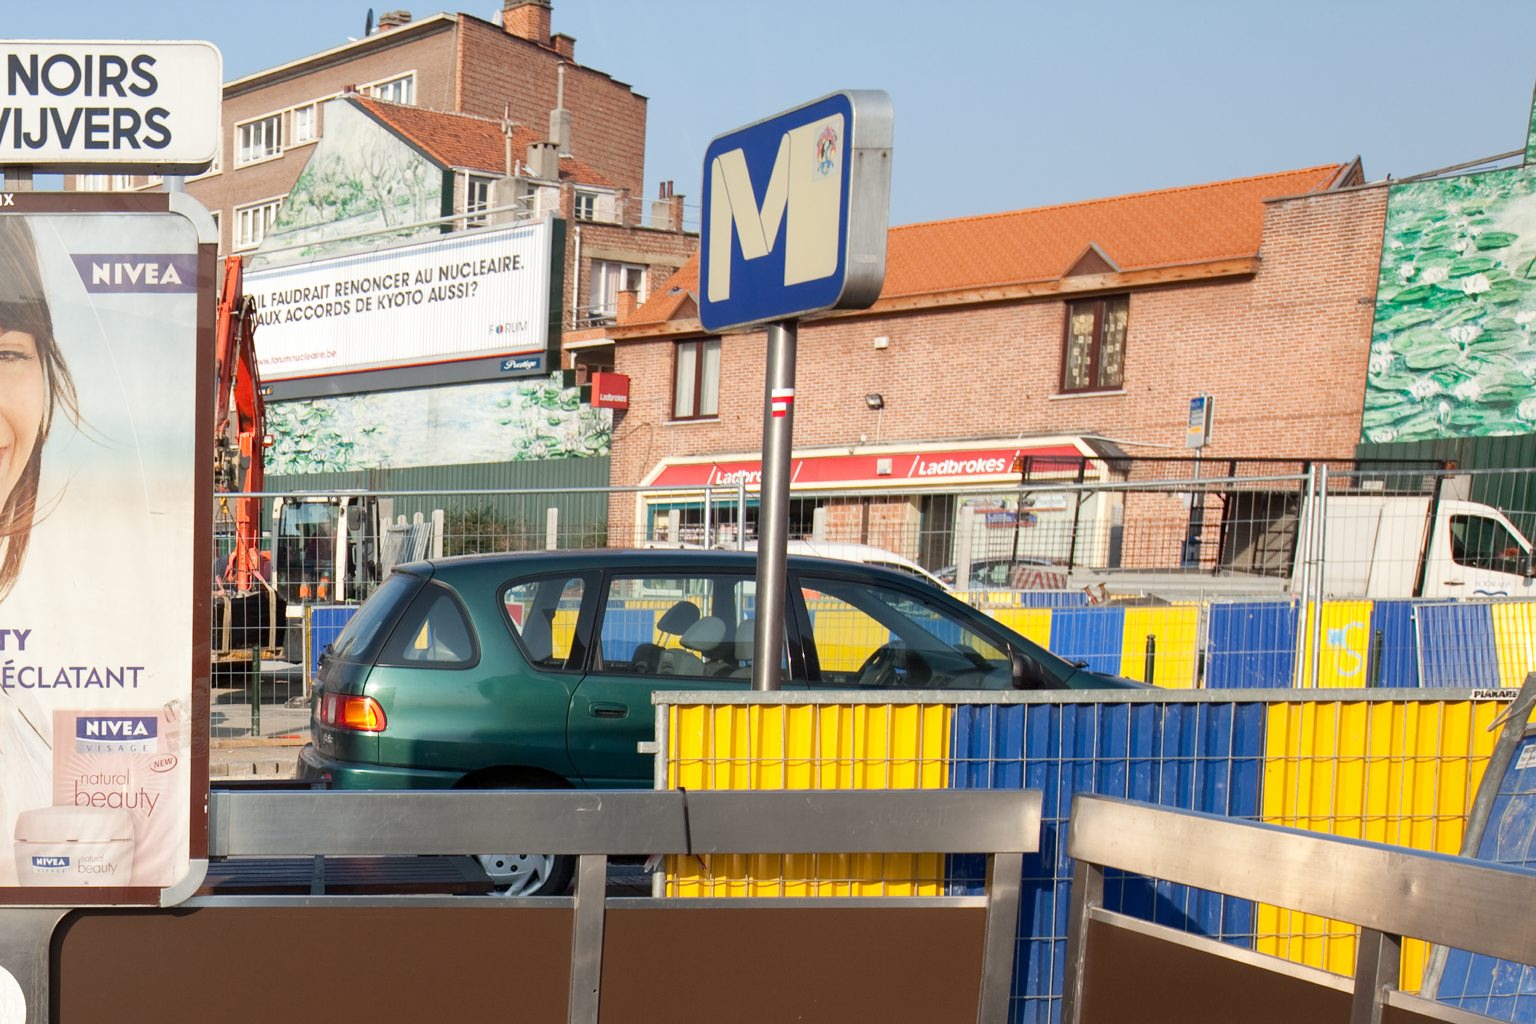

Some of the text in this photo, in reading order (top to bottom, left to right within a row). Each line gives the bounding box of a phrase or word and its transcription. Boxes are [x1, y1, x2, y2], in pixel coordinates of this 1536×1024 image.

[7, 53, 159, 98] NOIRS
[708, 112, 844, 303] M
[92, 262, 182, 285] NIVEA
[270, 284, 331, 308] FAUDRAIT
[335, 272, 410, 298] RENONCER
[414, 268, 433, 285] AU
[257, 281, 478, 326] AUX ACCORDS DE KYOTO AUSSI?
[599, 393, 627, 402] Ladbrokes
[716, 457, 1005, 484] Ladbro Ladbrokes
[2, 659, 144, 689] ÉCLATANT
[86, 720, 148, 736] NIVEA
[86, 744, 148, 752] VISAGE
[153, 758, 174, 769] NEW
[80, 768, 130, 785] natural
[75, 780, 160, 817] beauty
[36, 857, 66, 866] NIVEA
